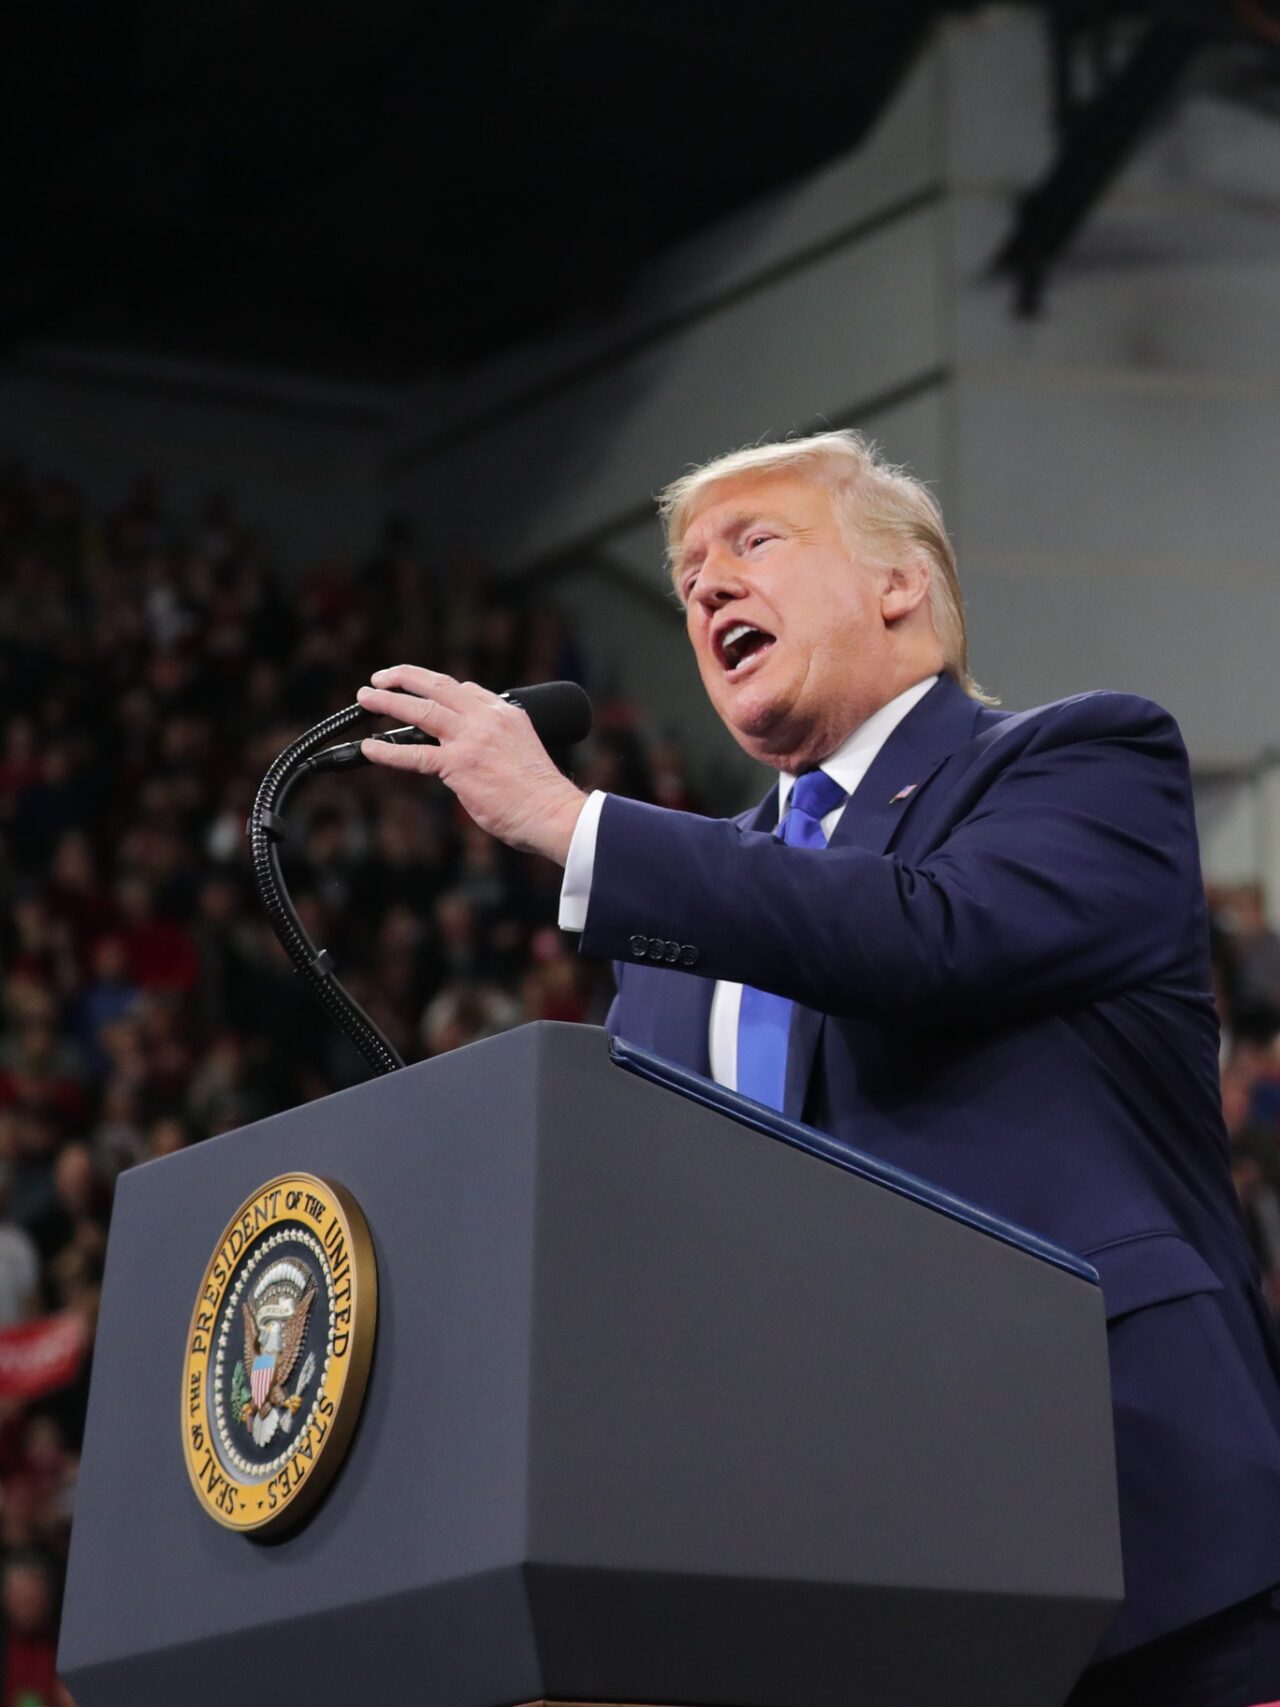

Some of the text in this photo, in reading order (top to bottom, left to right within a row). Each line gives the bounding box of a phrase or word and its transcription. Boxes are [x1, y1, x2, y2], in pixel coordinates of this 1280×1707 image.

[285, 1190, 303, 1210] OF
[304, 1193, 326, 1223] THE
[193, 1190, 281, 1354] PRESIDENT
[323, 1217, 351, 1358] UNITED
[190, 1371, 201, 1417] THE
[191, 1424, 203, 1451] OF
[267, 1396, 334, 1509] STATES
[199, 1448, 239, 1515] SEAL
